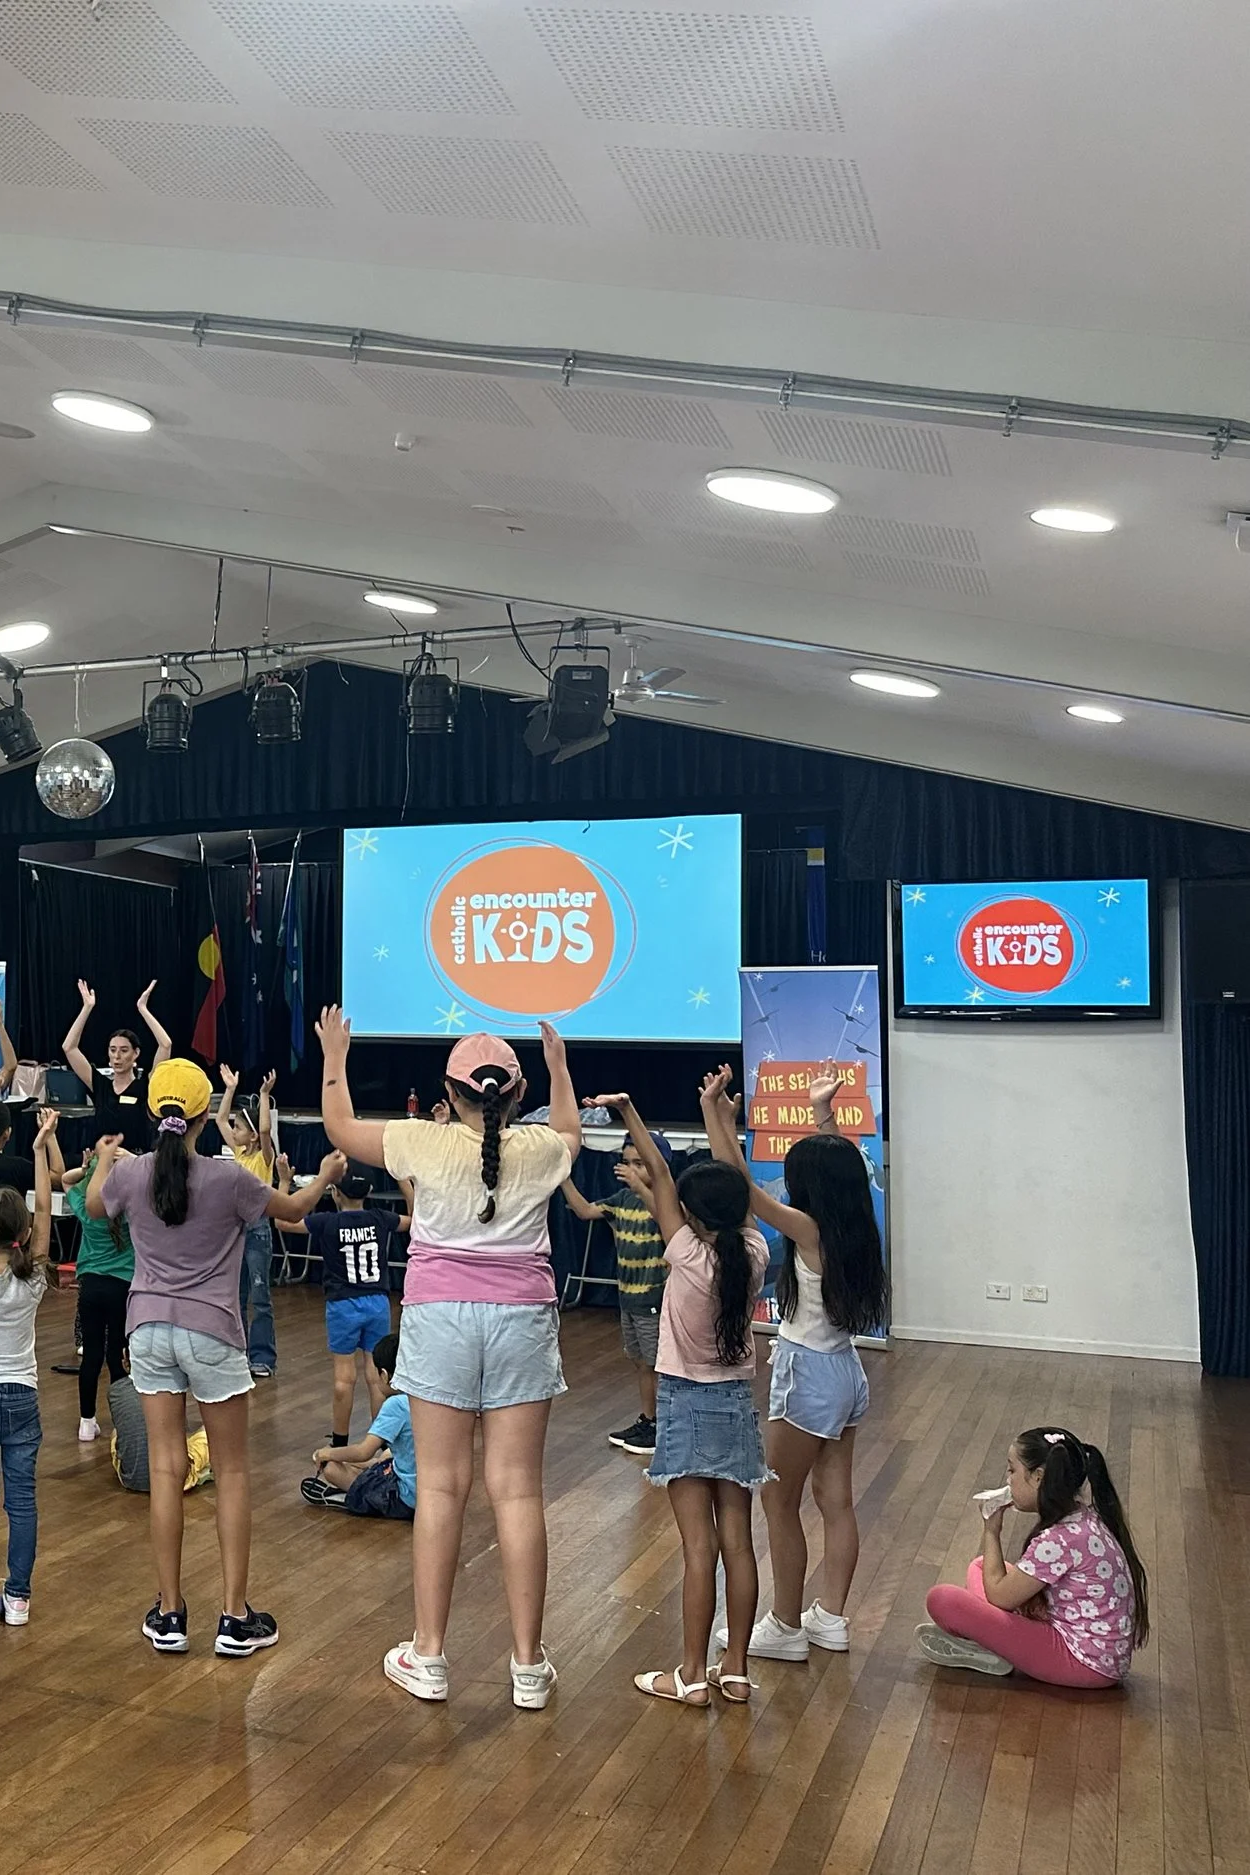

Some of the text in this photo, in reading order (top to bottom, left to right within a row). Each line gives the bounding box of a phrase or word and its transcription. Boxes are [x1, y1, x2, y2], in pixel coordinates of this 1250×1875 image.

[470, 888, 597, 910] encounter
[450, 895, 467, 965] catholic
[984, 922, 1063, 935] encounter
[972, 926, 984, 966] catholic
[760, 1074, 785, 1093] THE
[753, 1105, 864, 1126] HE MADE AND
[339, 1225, 377, 1243] FRANCE
[339, 1242, 381, 1285] 10
